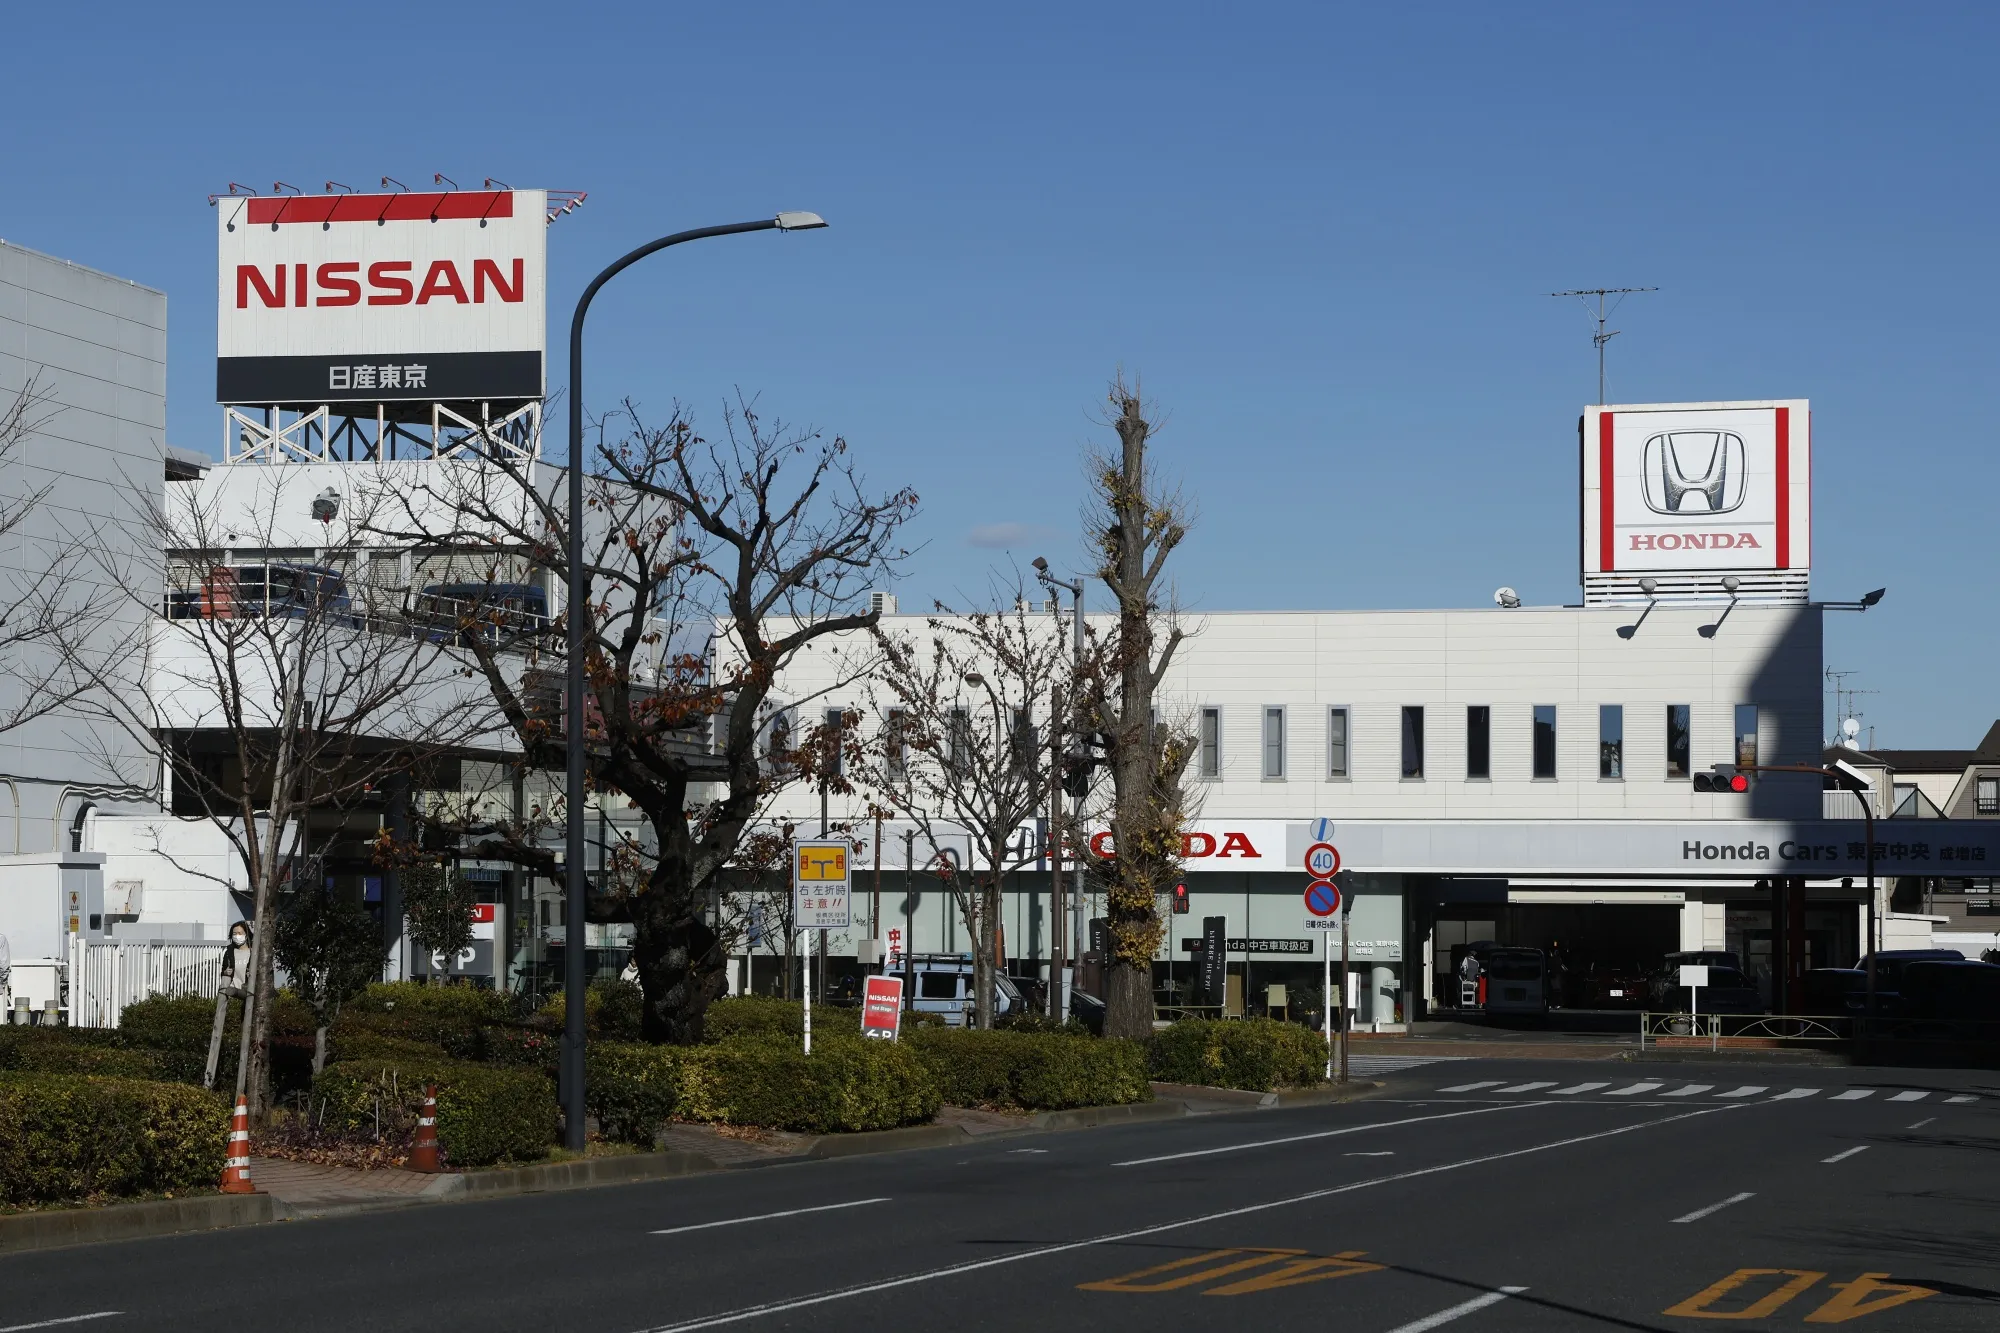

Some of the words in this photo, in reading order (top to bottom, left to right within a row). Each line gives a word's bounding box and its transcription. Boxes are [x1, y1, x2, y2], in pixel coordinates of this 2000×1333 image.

[236, 258, 524, 309] NISSAN
[329, 364, 428, 390] 日産東京
[1629, 532, 1762, 551] HONDA
[1682, 841, 1770, 860] Honda
[1778, 841, 1839, 860] Cars
[1847, 842, 1930, 860] 東京中央
[1939, 847, 1986, 861] 成増店
[1313, 853, 1332, 869] 40
[1249, 941, 1309, 952] 中古車取扱店
[1356, 940, 1373, 948] Cars
[868, 994, 898, 1003] NISSAN
[1662, 1268, 1942, 1323] 40
